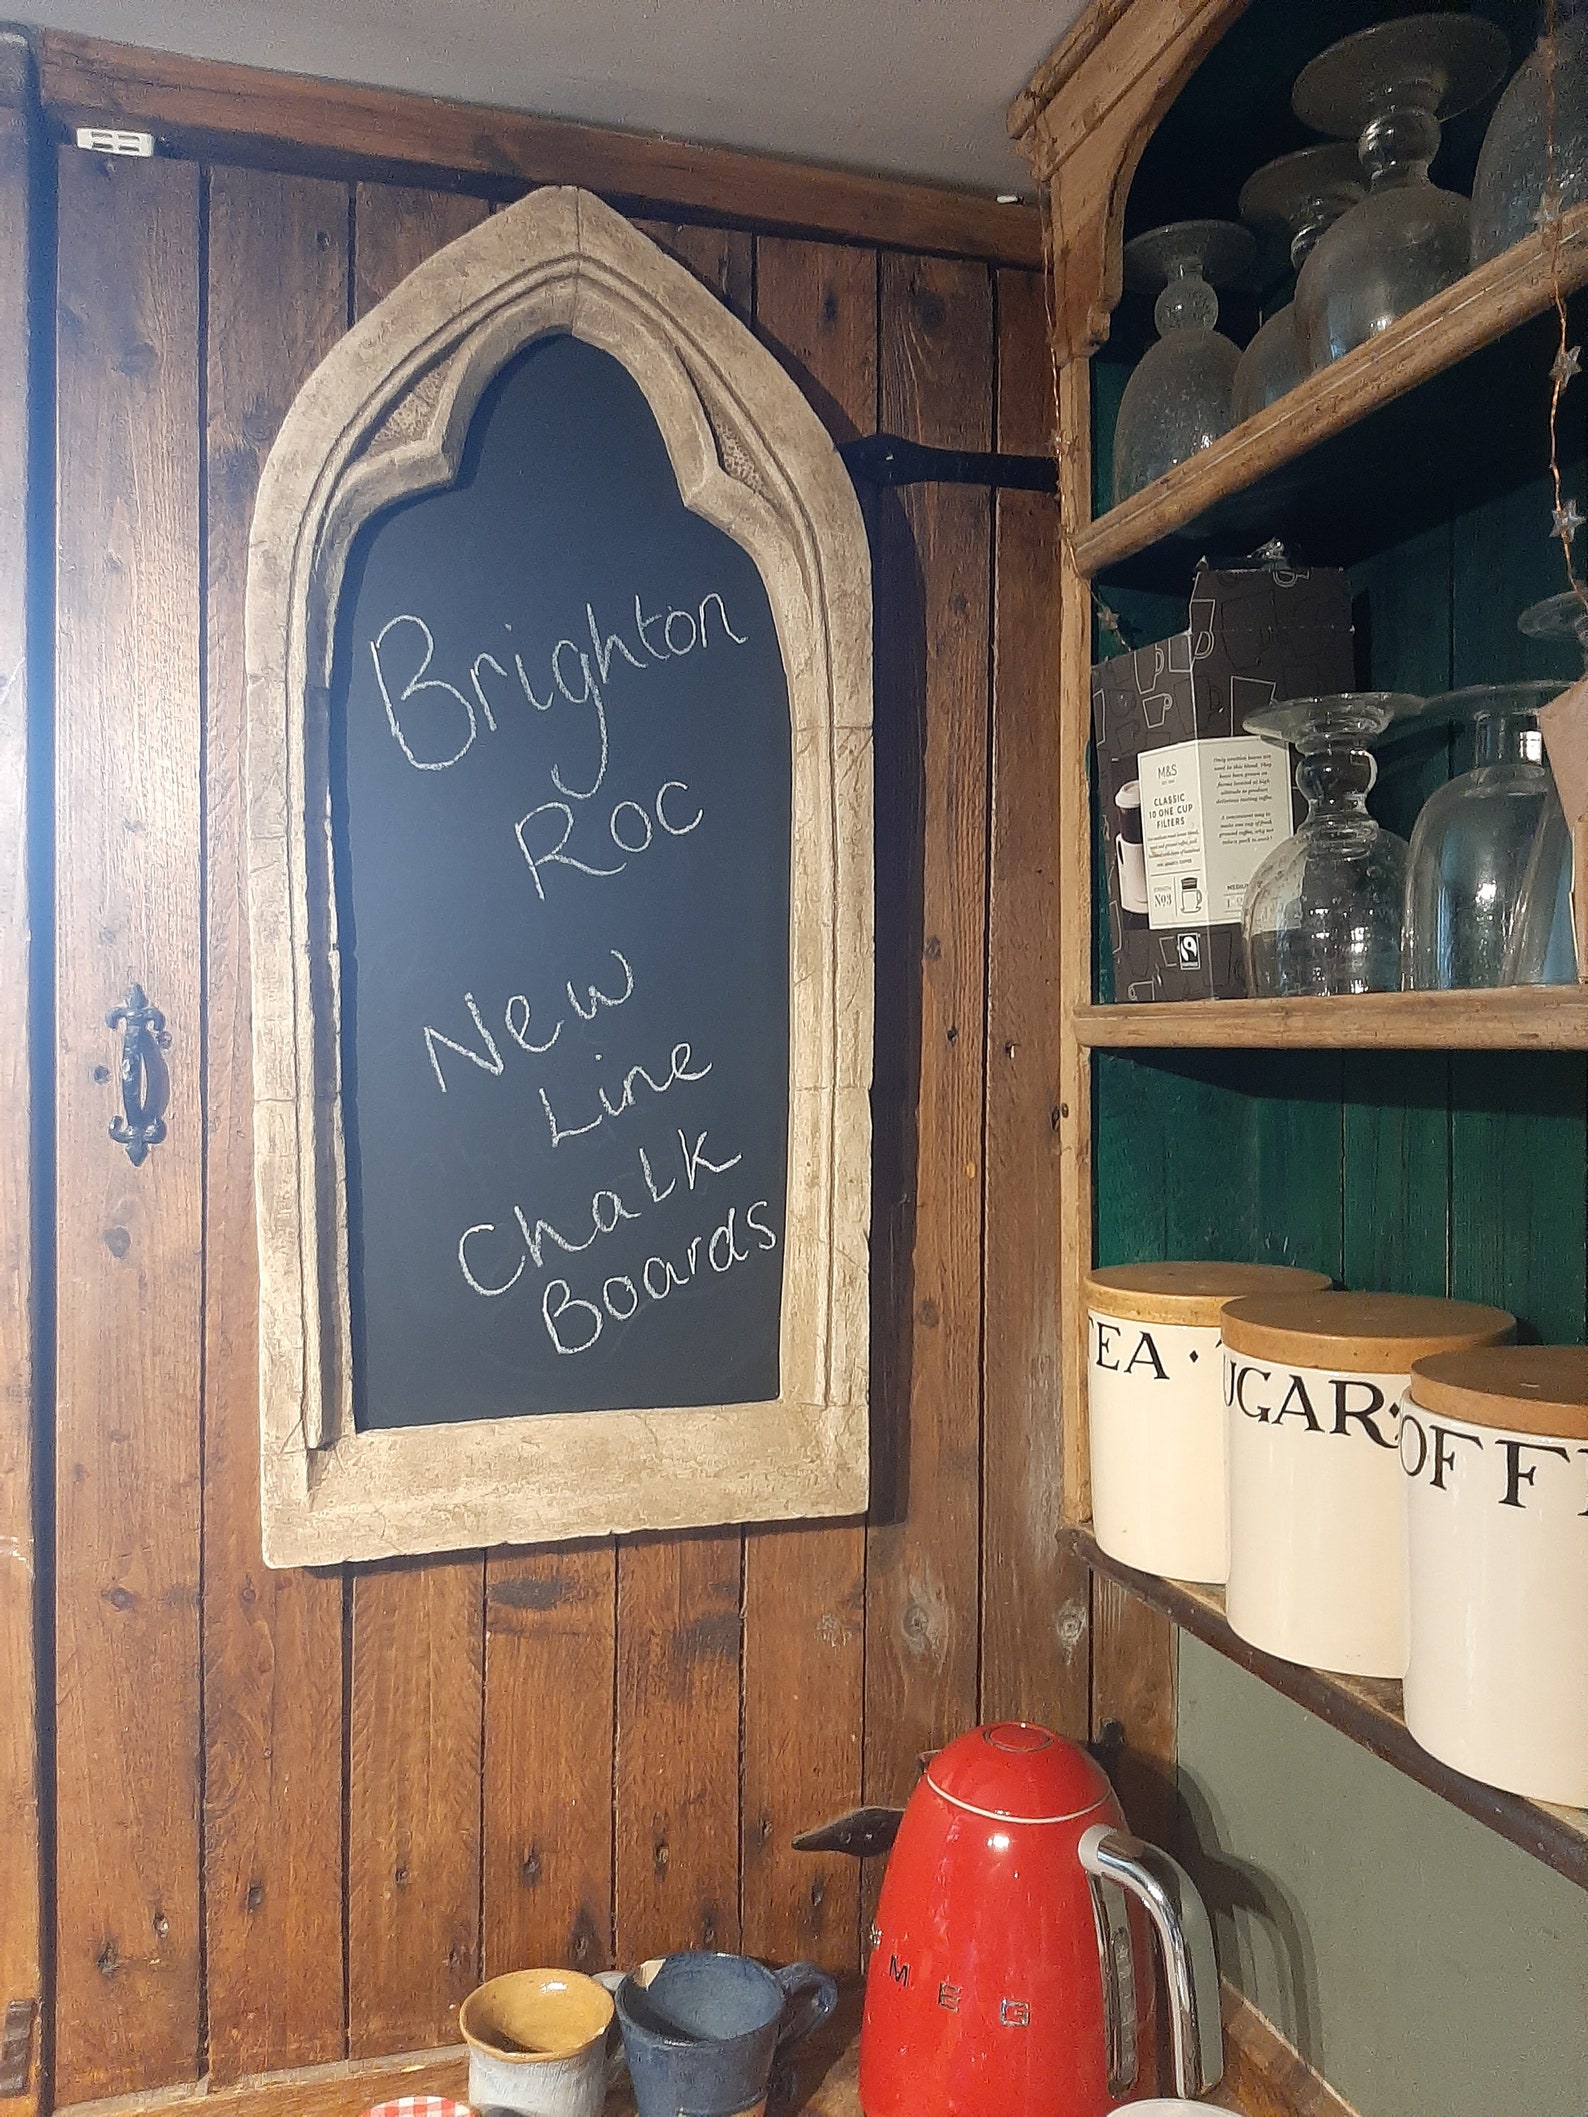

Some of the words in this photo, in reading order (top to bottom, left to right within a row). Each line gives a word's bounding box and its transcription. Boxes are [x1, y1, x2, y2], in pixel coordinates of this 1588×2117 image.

[369, 592, 749, 800] Brighton
[1149, 811, 1157, 819] 10
[1159, 806, 1174, 817] ONE
[1177, 803, 1193, 814] CUP
[1153, 793, 1186, 807] CLASSIC
[1157, 816, 1186, 829] FILTERS
[1158, 764, 1178, 779] M&S
[514, 781, 704, 901] Roc
[423, 949, 635, 1093] New
[538, 1042, 713, 1149] Line
[542, 1201, 777, 1354] Boards
[1088, 1315, 1170, 1380] EA
[1400, 1415, 1588, 1517] OFF
